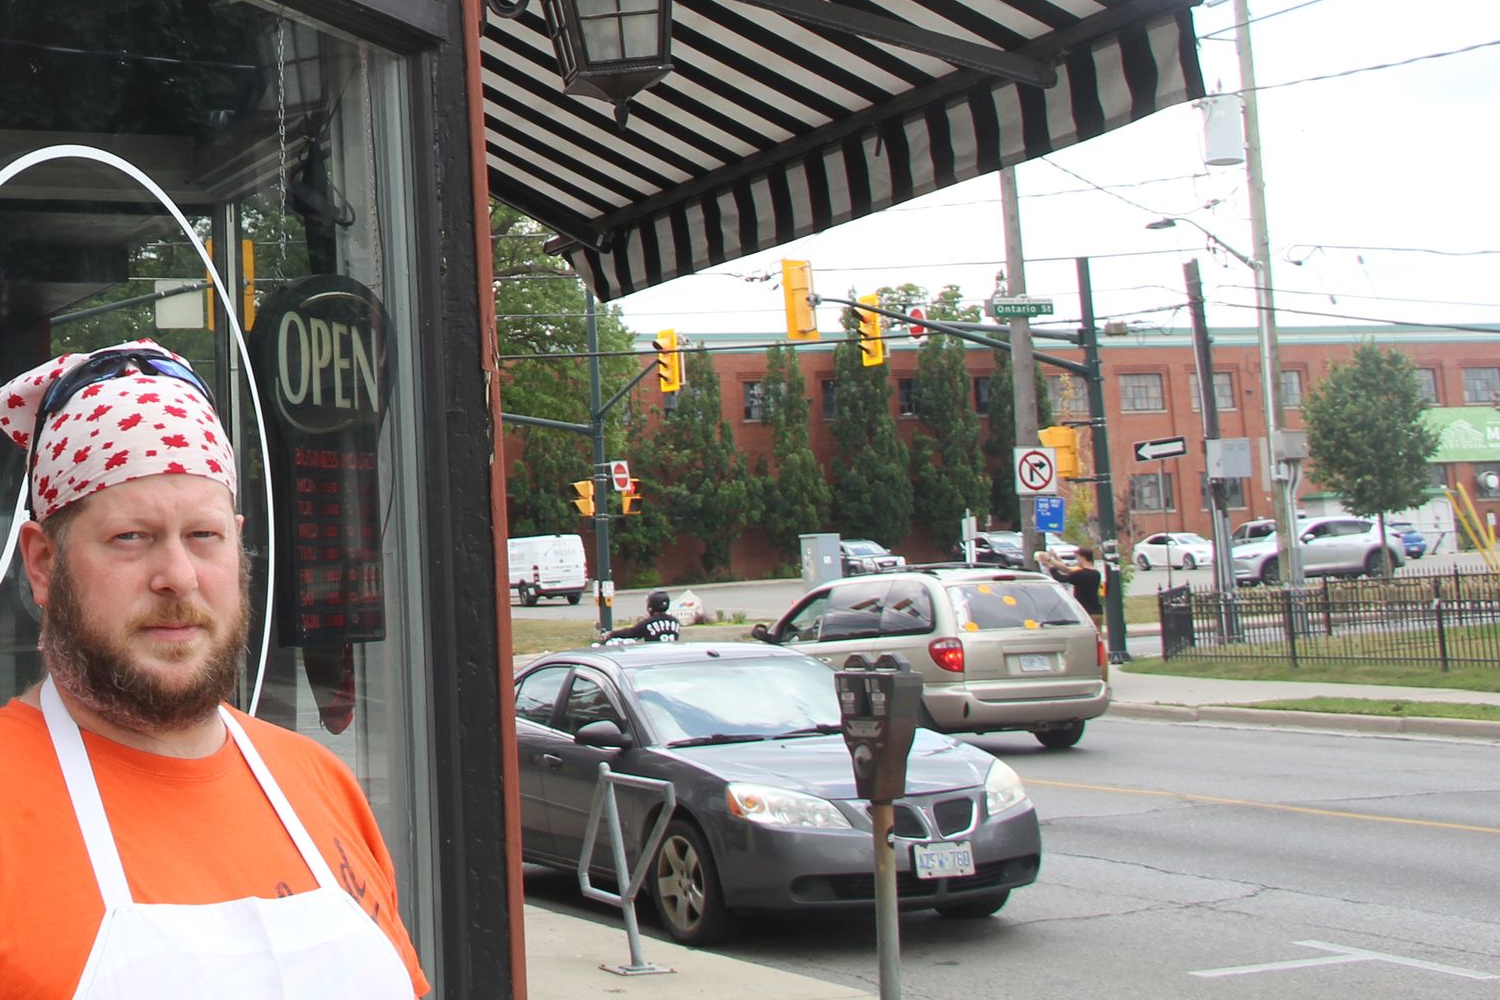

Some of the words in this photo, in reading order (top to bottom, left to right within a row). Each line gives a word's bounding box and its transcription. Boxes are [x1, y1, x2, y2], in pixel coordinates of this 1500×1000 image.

[996, 304, 1037, 313] Ontario
[1041, 304, 1052, 313] St
[277, 311, 379, 413] OPEN
